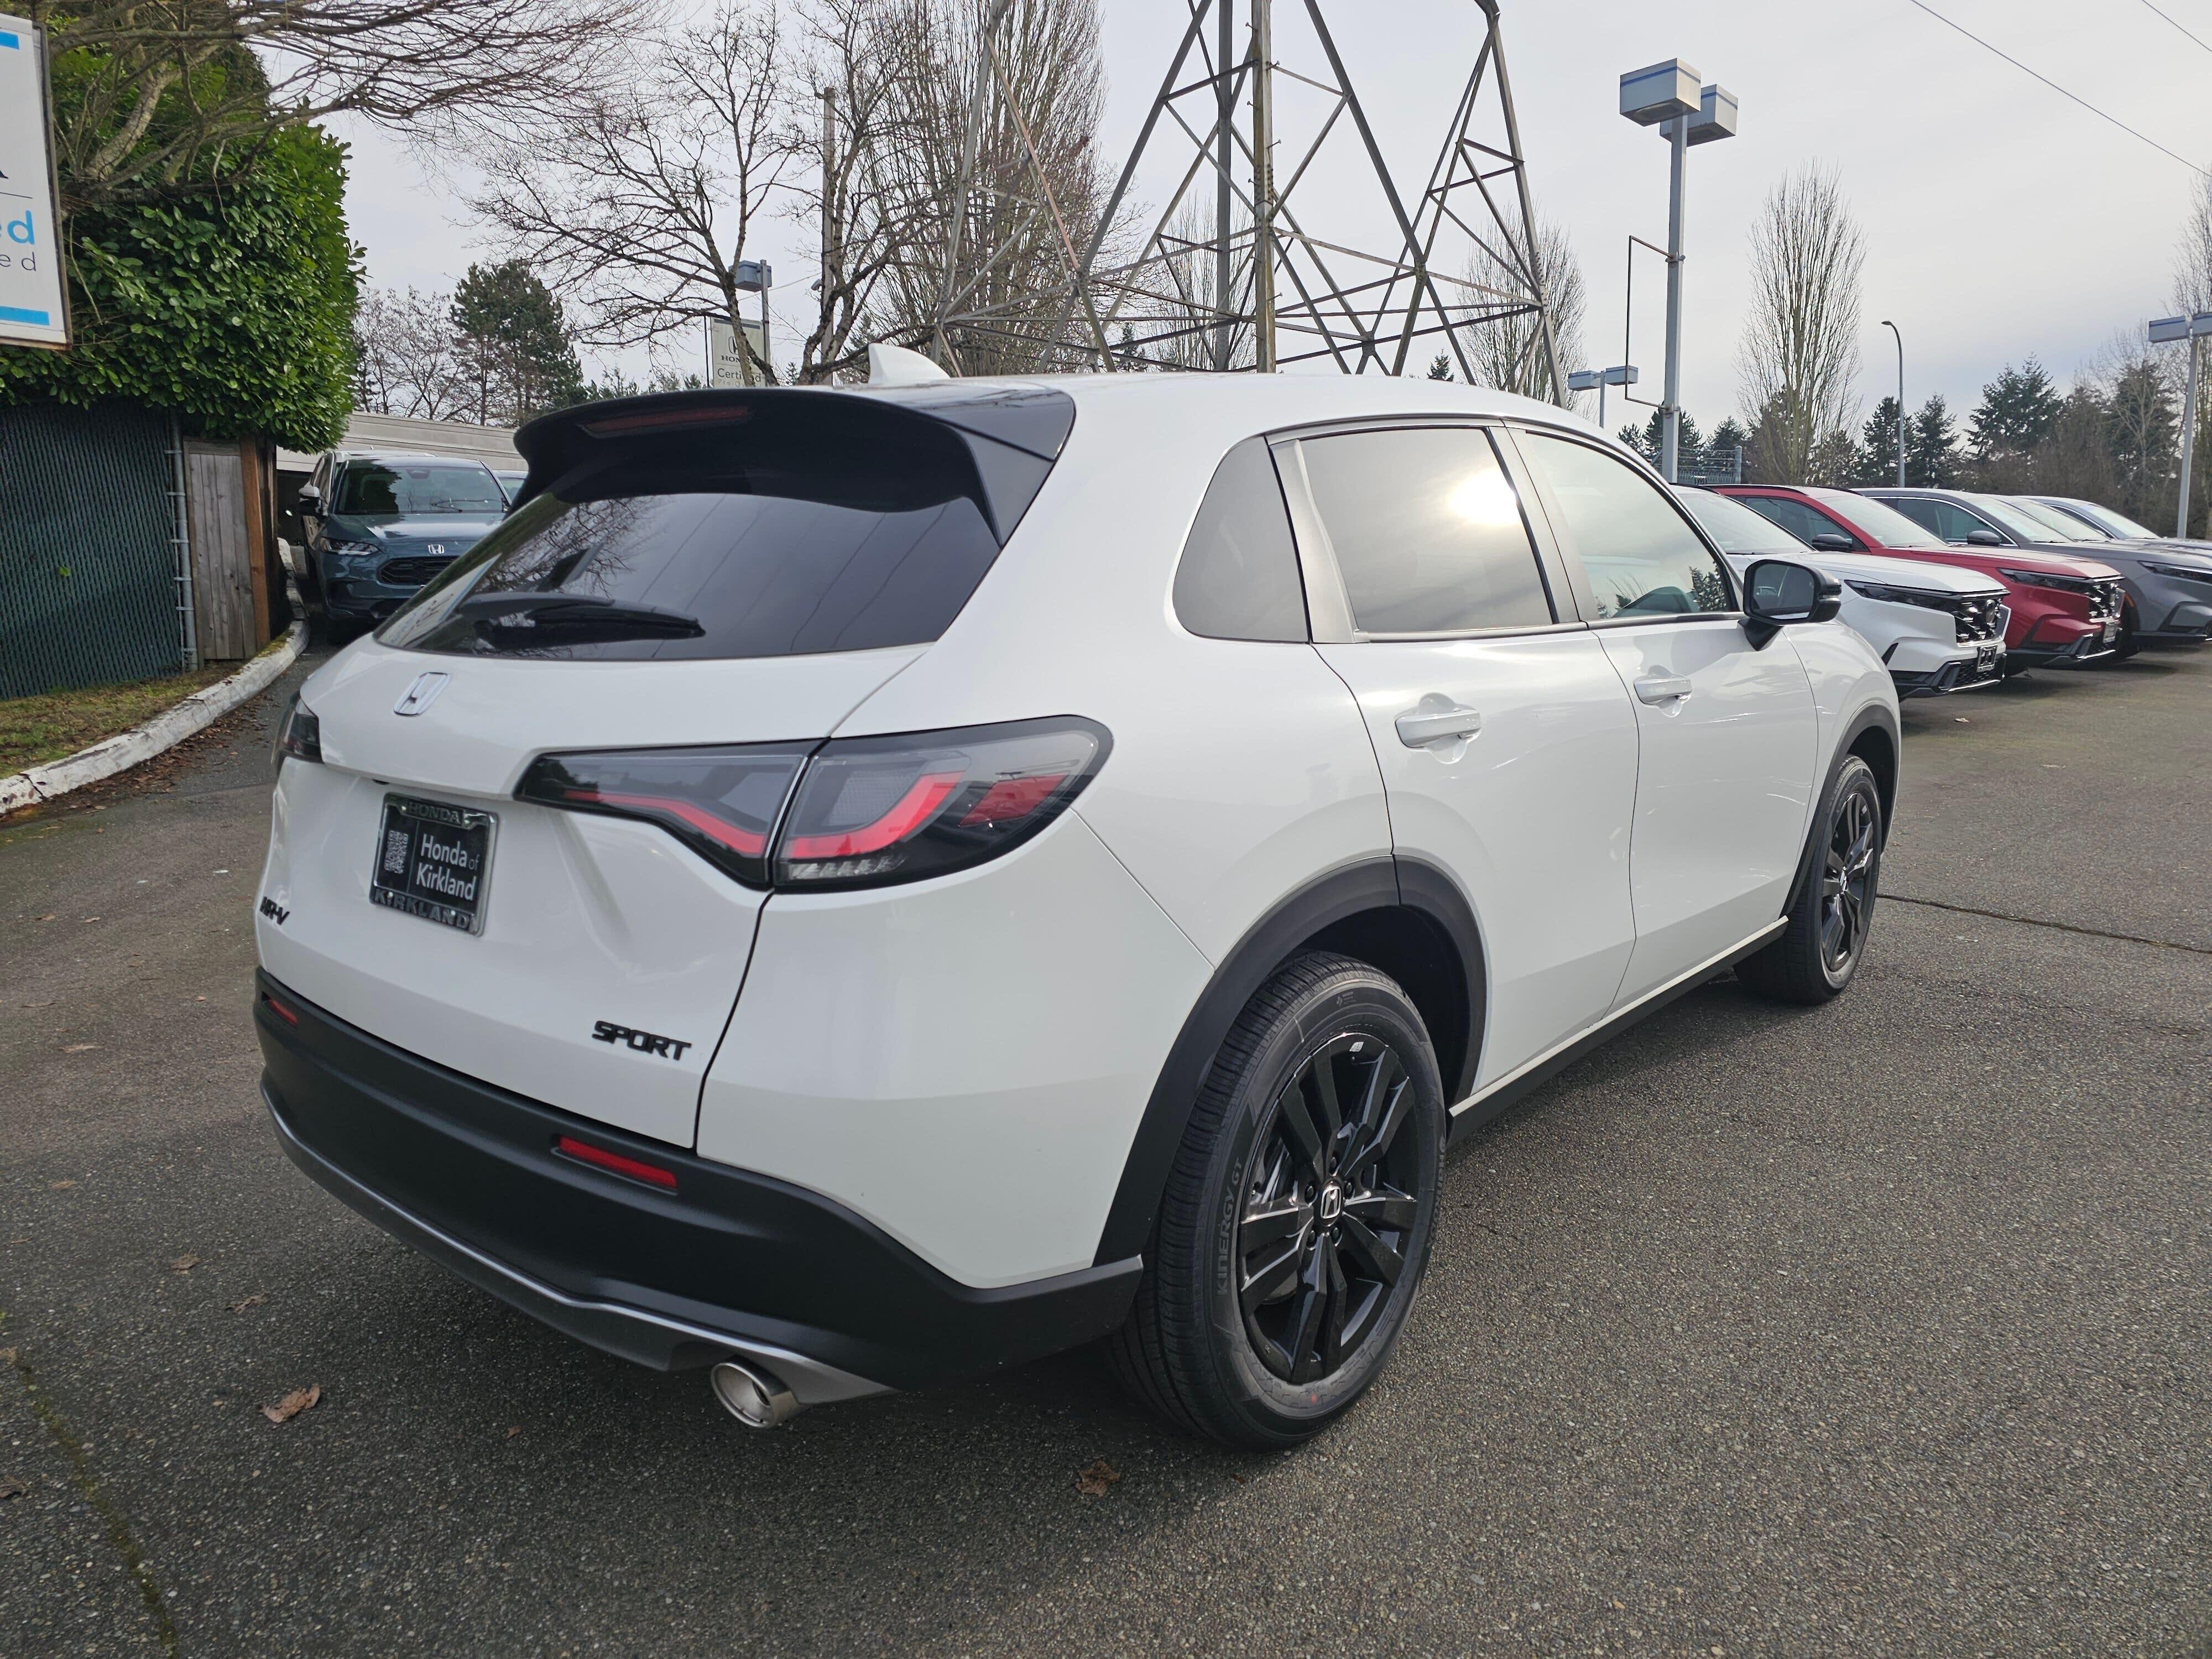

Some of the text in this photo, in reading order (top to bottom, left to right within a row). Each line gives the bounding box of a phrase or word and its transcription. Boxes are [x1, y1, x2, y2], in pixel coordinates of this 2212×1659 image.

[409, 801, 460, 825] HONDA
[421, 833, 479, 870] Honda of
[416, 863, 477, 901] Kirkland
[374, 887, 469, 929] KIRKLAND
[592, 1020, 692, 1061] SPORT
[1217, 1157, 1241, 1295] KINERGY GT
